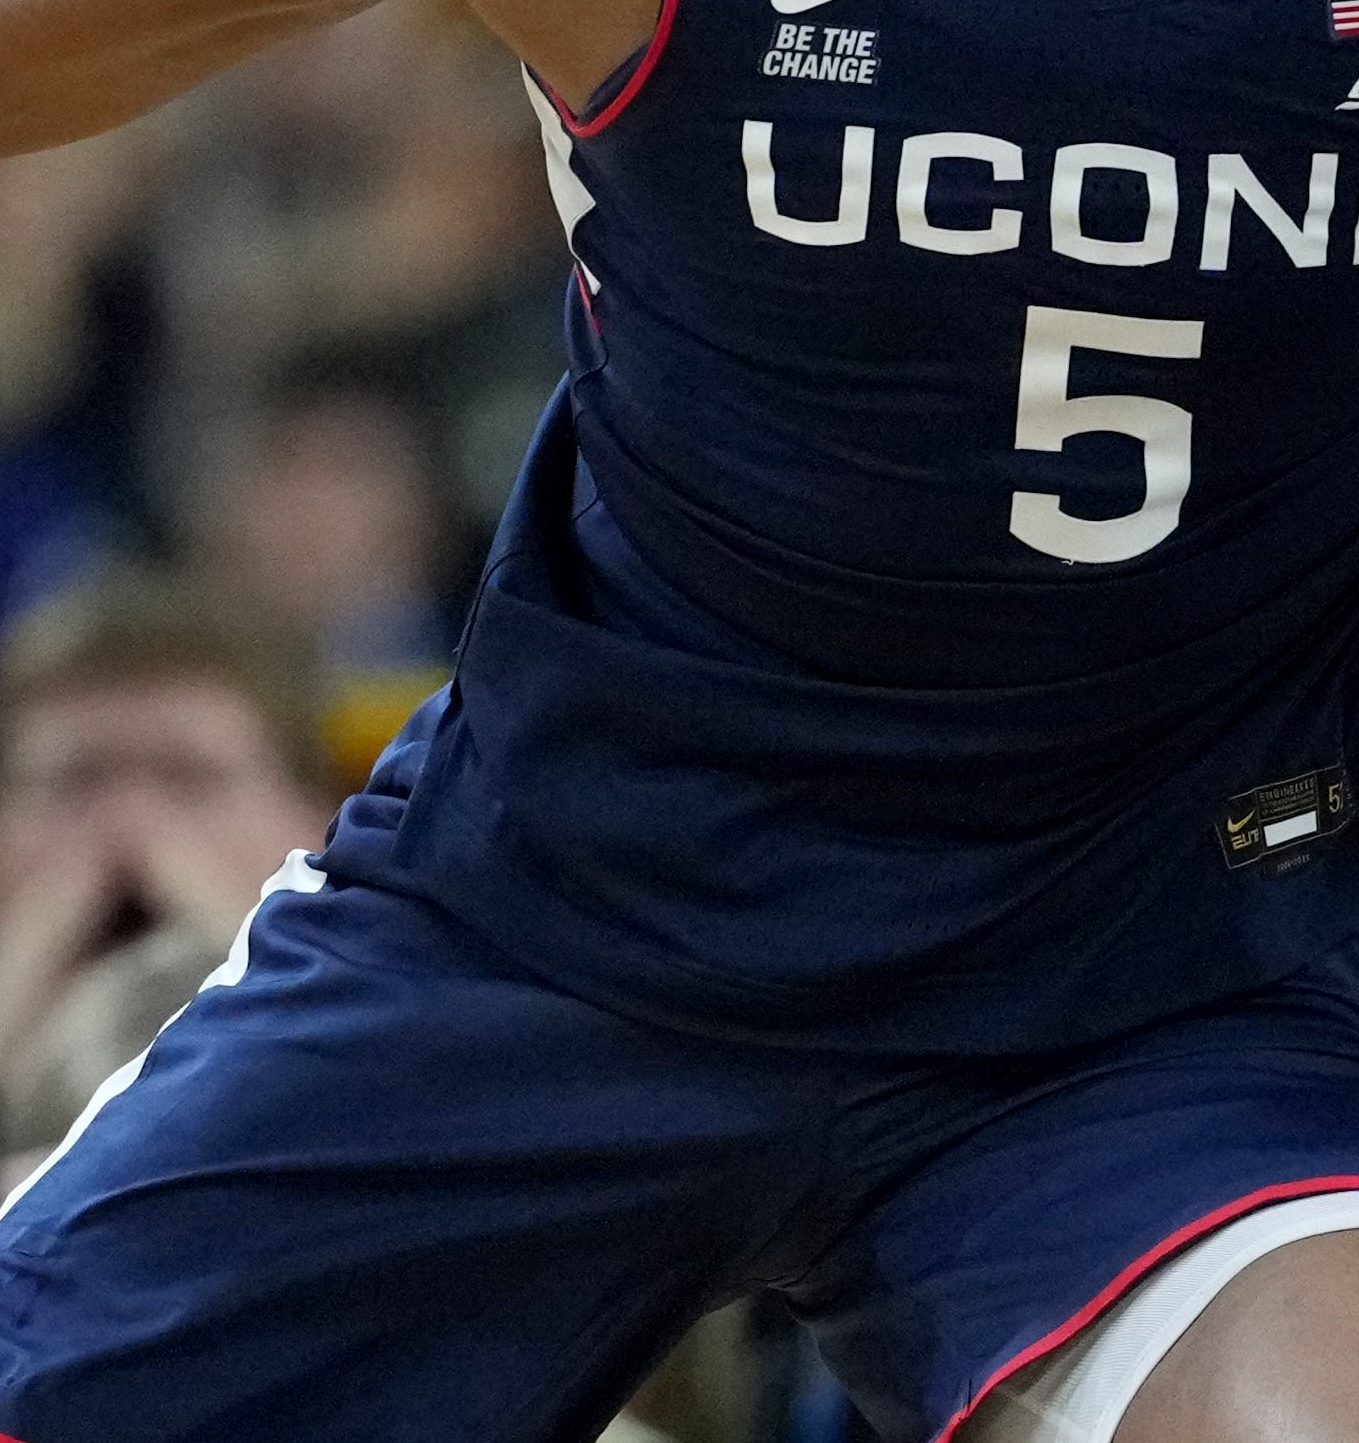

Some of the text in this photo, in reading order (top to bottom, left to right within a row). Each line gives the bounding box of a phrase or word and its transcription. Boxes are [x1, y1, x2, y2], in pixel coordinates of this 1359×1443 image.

[776, 23, 876, 57] BE THE
[762, 50, 878, 85] CHANGE
[1008, 304, 1206, 566] 5
